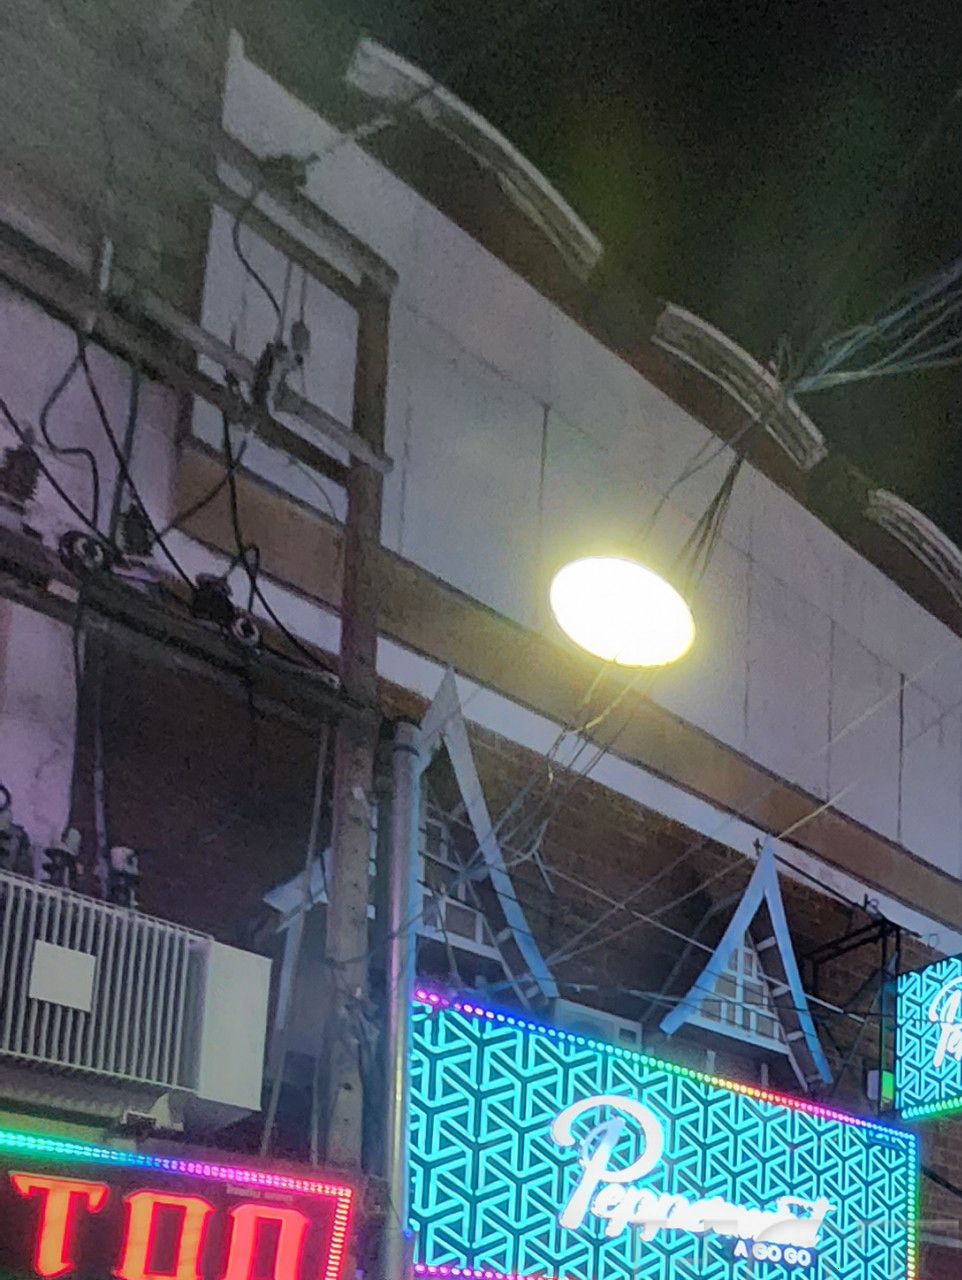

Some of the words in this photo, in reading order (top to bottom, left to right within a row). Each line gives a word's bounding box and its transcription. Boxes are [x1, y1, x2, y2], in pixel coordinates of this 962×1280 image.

[733, 1240, 749, 1258] A
[752, 1242, 782, 1263] GO
[783, 1247, 812, 1268] GO
